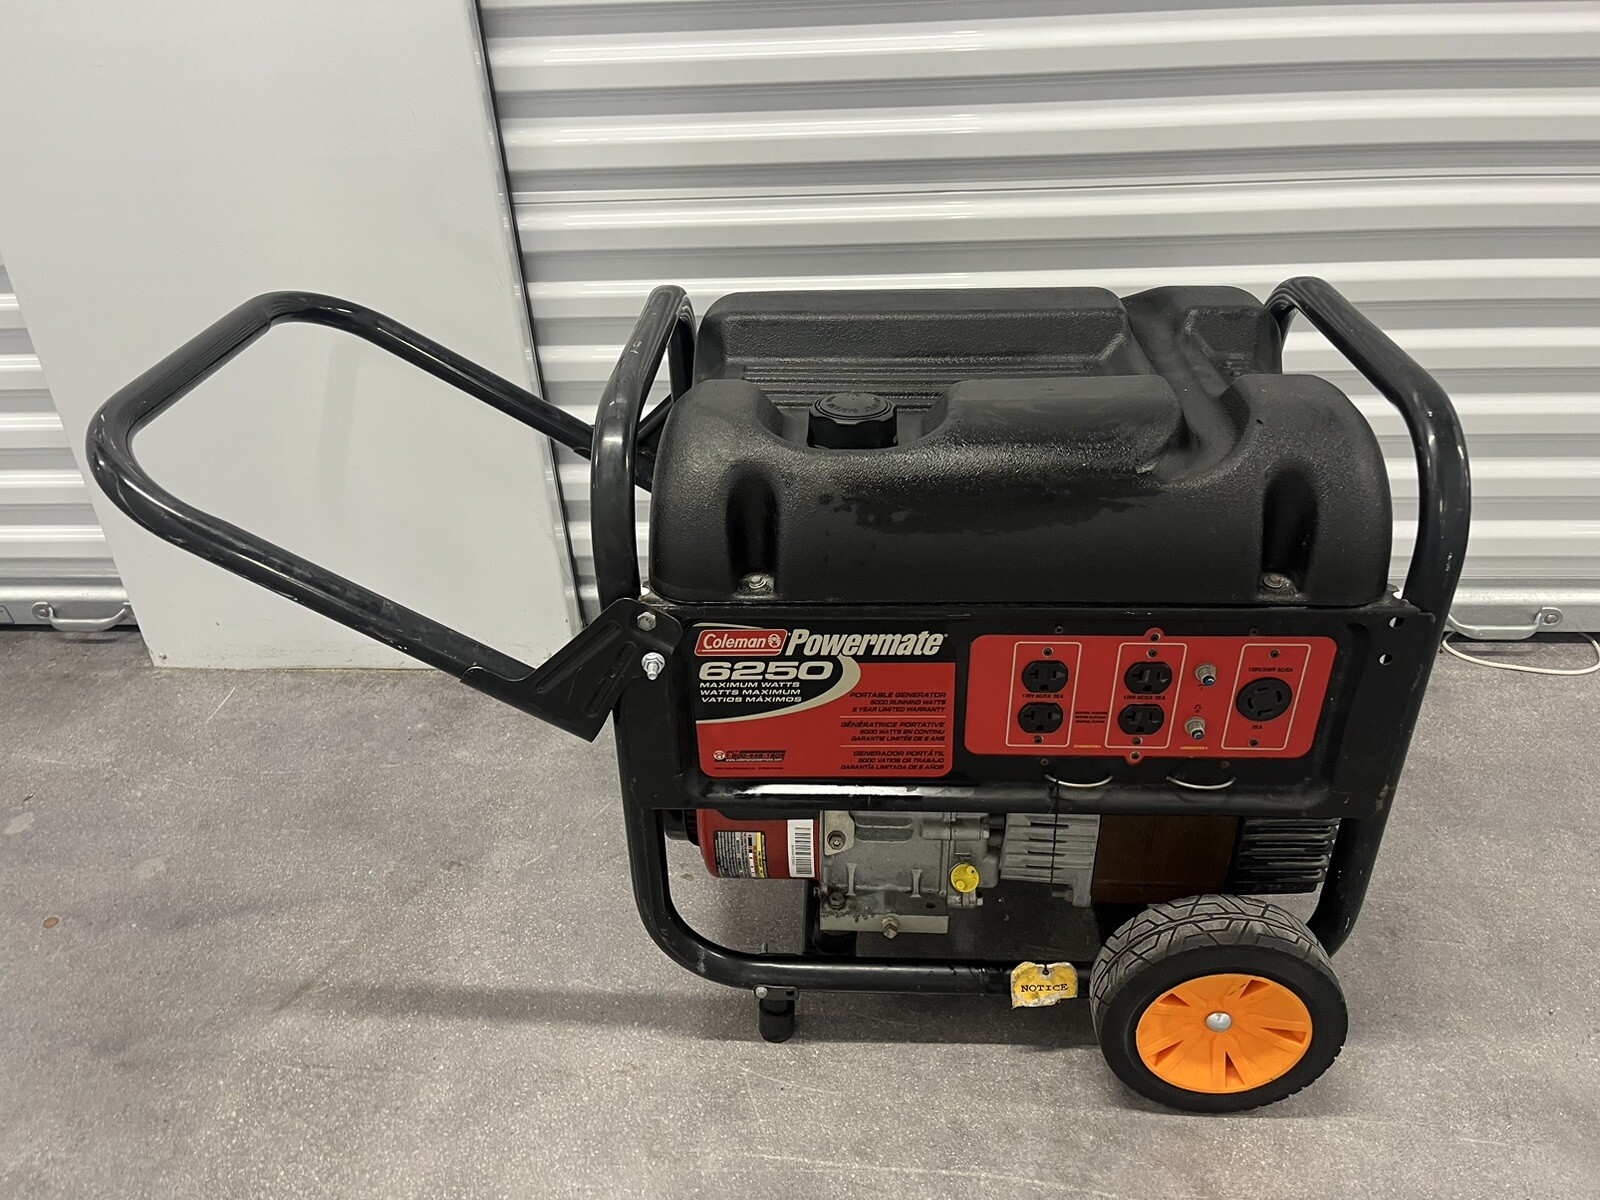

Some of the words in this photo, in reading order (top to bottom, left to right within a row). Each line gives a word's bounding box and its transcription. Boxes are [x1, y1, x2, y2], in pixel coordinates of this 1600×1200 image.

[703, 633, 767, 649] Coleman
[785, 629, 944, 656] Powermate
[699, 661, 834, 680] 6250
[906, 749, 945, 757] PORTÁTIL
[1021, 983, 1068, 992] NOTICE
